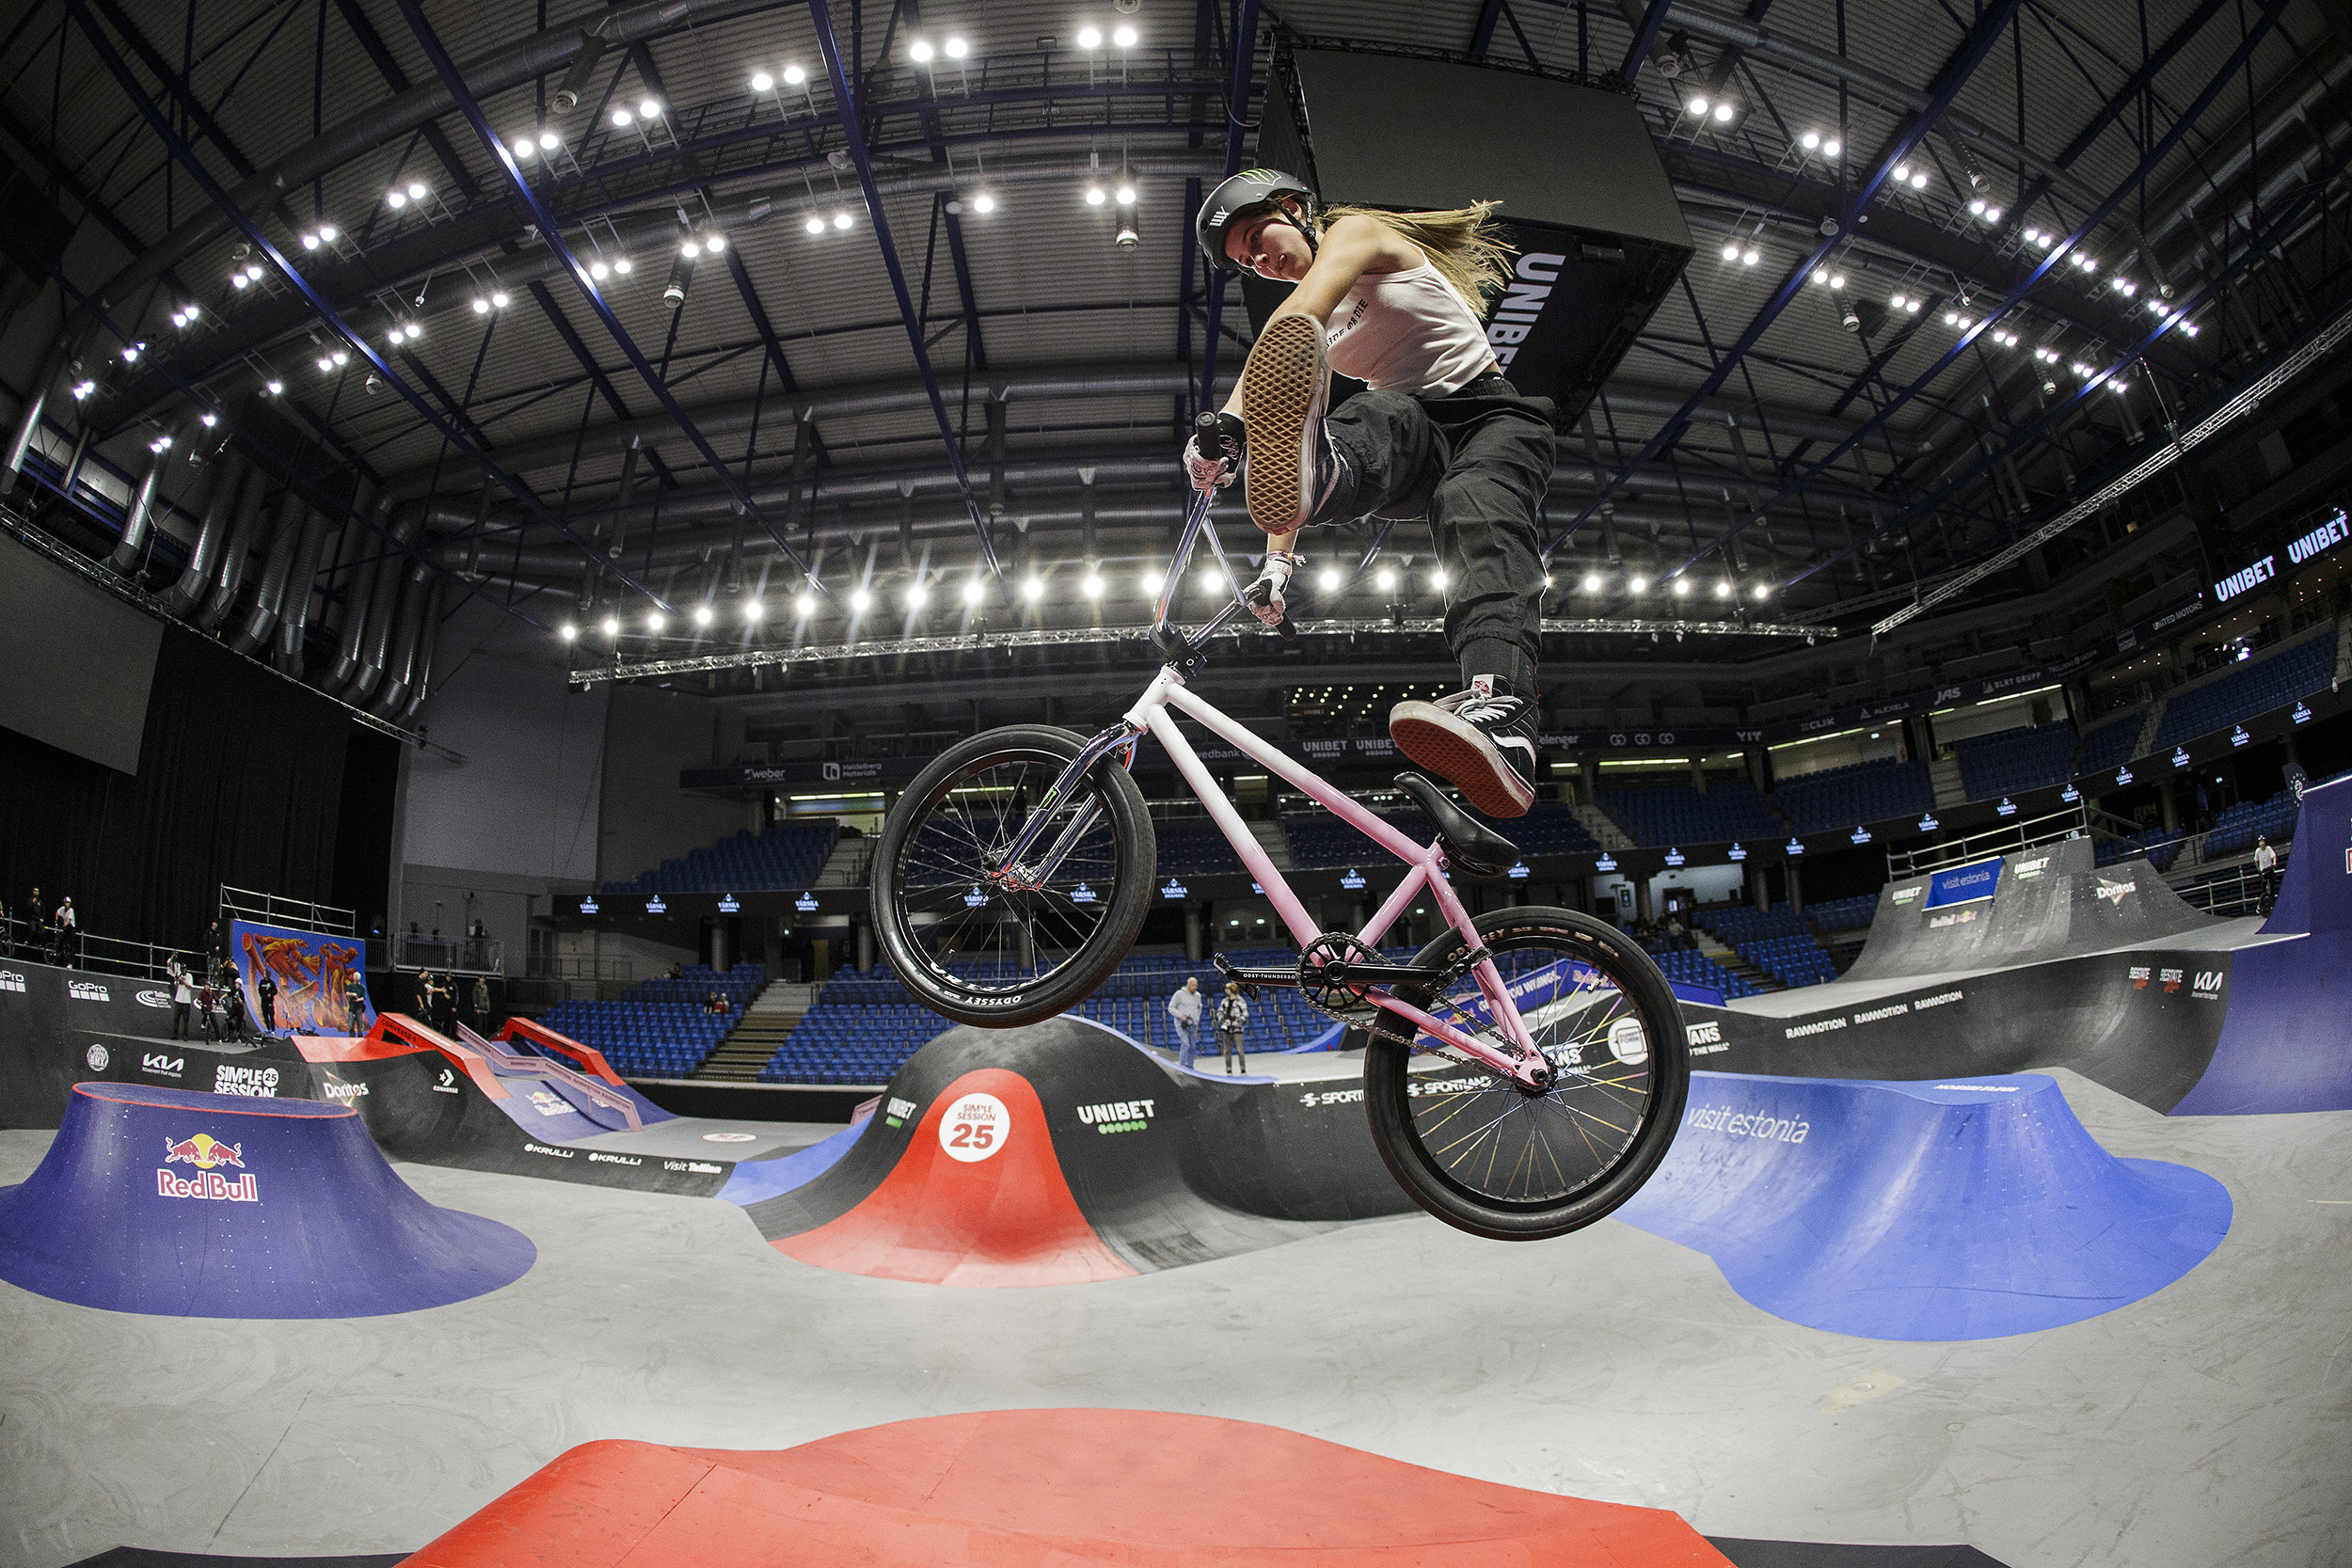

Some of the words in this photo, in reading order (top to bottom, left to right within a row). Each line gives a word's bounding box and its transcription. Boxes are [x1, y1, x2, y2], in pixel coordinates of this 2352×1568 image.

[1486, 252, 1565, 374] UNIBE
[2214, 555, 2275, 602] UNIBET
[2287, 514, 2349, 563] UNIBET
[2153, 614, 2176, 631] UNITED
[2176, 600, 2203, 621] MOTORS
[1994, 678, 2014, 689] BLRT
[2016, 672, 2041, 684] GRUPP
[1934, 687, 1962, 705] JAS
[1736, 731, 1762, 741] YIT
[1302, 740, 1348, 752] UNIBET
[753, 768, 786, 779] weber
[843, 763, 882, 771] Heidelberg
[2014, 857, 2049, 874] UNIBET
[2096, 881, 2137, 898] Doritos
[68, 980, 107, 993] GoPro
[964, 994, 1025, 1006] ODYSSEY
[142, 1053, 184, 1072] KIA
[215, 1065, 262, 1085] SIMPLE
[264, 1073, 278, 1083] 25
[214, 1081, 276, 1098] SESSION
[323, 1082, 369, 1098] Doritos
[433, 1085, 459, 1094] CONVERSE
[956, 1112, 996, 1121] SESSION
[962, 1103, 993, 1113] SIMPLE
[1076, 1099, 1154, 1125] UNIBET
[1687, 1102, 1732, 1132] visit
[1727, 1109, 1810, 1145] estonia
[949, 1123, 994, 1149] 25
[532, 1146, 574, 1158] KRULLI
[597, 1154, 643, 1165] KRULLI
[664, 1160, 688, 1172] Visit
[688, 1162, 723, 1174] Tallinn
[157, 1168, 208, 1199] Red
[207, 1172, 258, 1202] Bull
